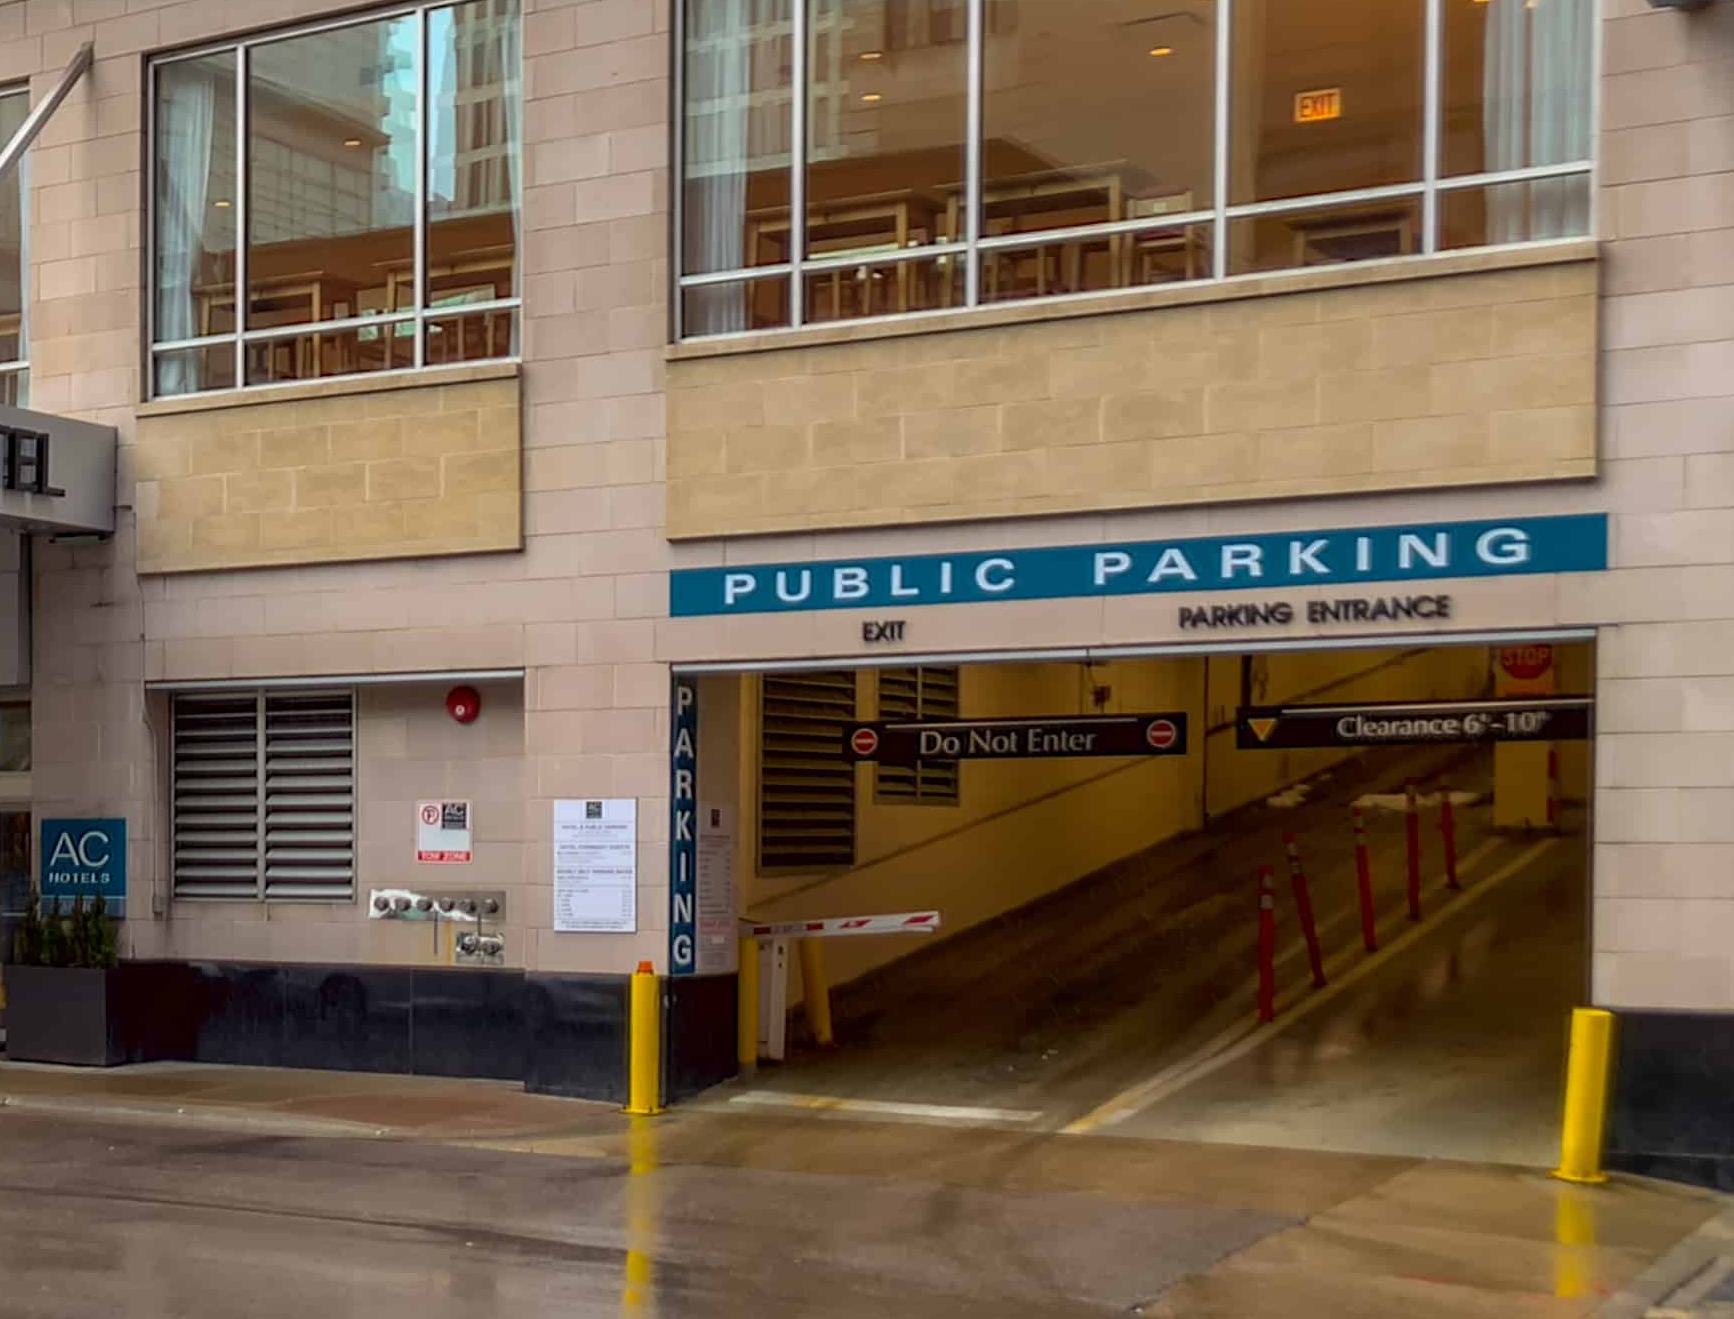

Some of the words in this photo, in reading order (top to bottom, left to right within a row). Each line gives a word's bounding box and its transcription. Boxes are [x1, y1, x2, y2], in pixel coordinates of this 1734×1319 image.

[1300, 93, 1337, 118] EXIT
[724, 558, 1016, 605] PUBLIC
[1094, 528, 1531, 585] PARKING
[1178, 600, 1294, 629] PARKING
[1306, 595, 1451, 624] ENTRANCE
[861, 620, 906, 642] EXIT
[1502, 646, 1550, 666] STOP
[1337, 714, 1460, 737] Clearance
[919, 730, 960, 755] Do
[968, 729, 1017, 754] Not
[1027, 728, 1096, 753] Enter
[673, 686, 694, 965] PARKING
[49, 831, 109, 866] AC
[48, 872, 110, 884] HOTELS
